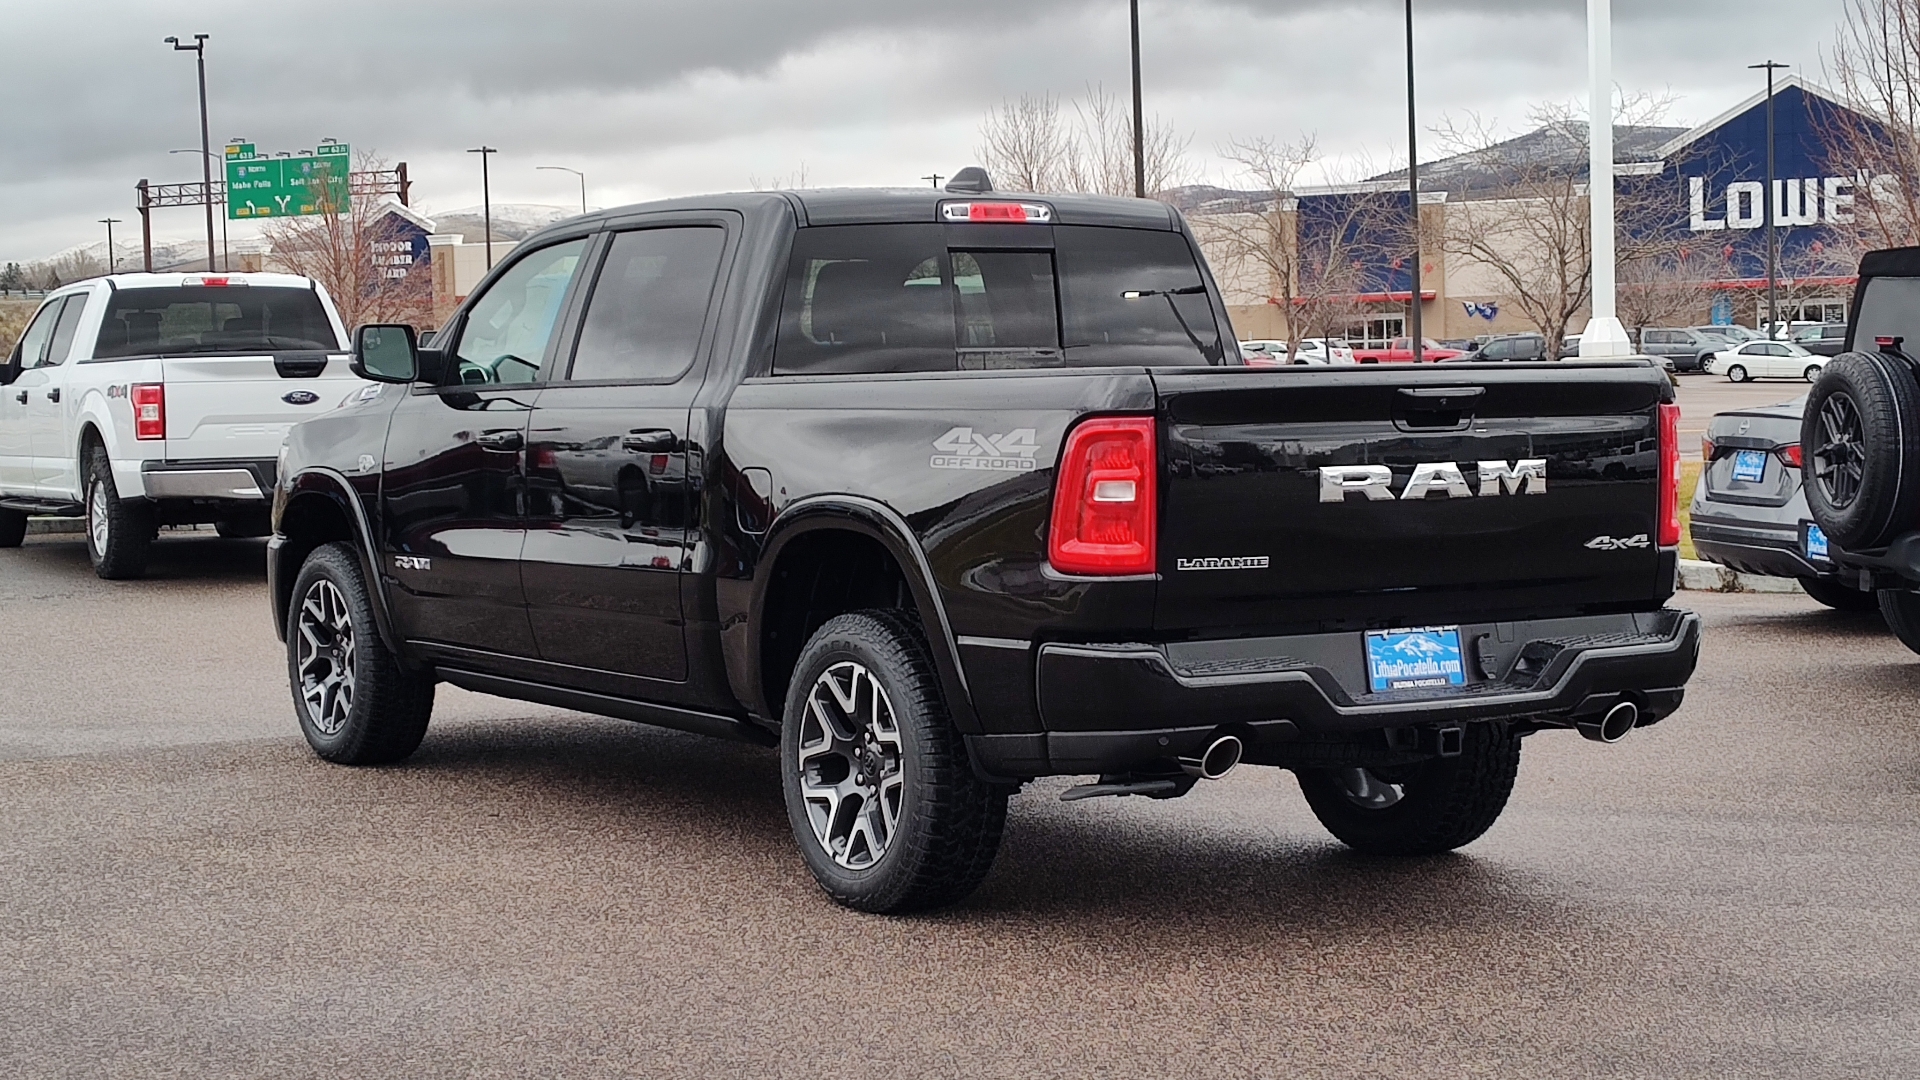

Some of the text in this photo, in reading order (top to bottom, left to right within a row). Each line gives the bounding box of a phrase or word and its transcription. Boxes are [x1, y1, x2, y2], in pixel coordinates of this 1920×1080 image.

[232, 180, 272, 190] Idaho Falls
[290, 177, 305, 186] Salt
[932, 457, 1034, 469] OFF ROAD
[1319, 458, 1547, 503] RAM
[1177, 556, 1269, 571] LARAMIE
[1371, 657, 1461, 678] LithiaPocatello.com
